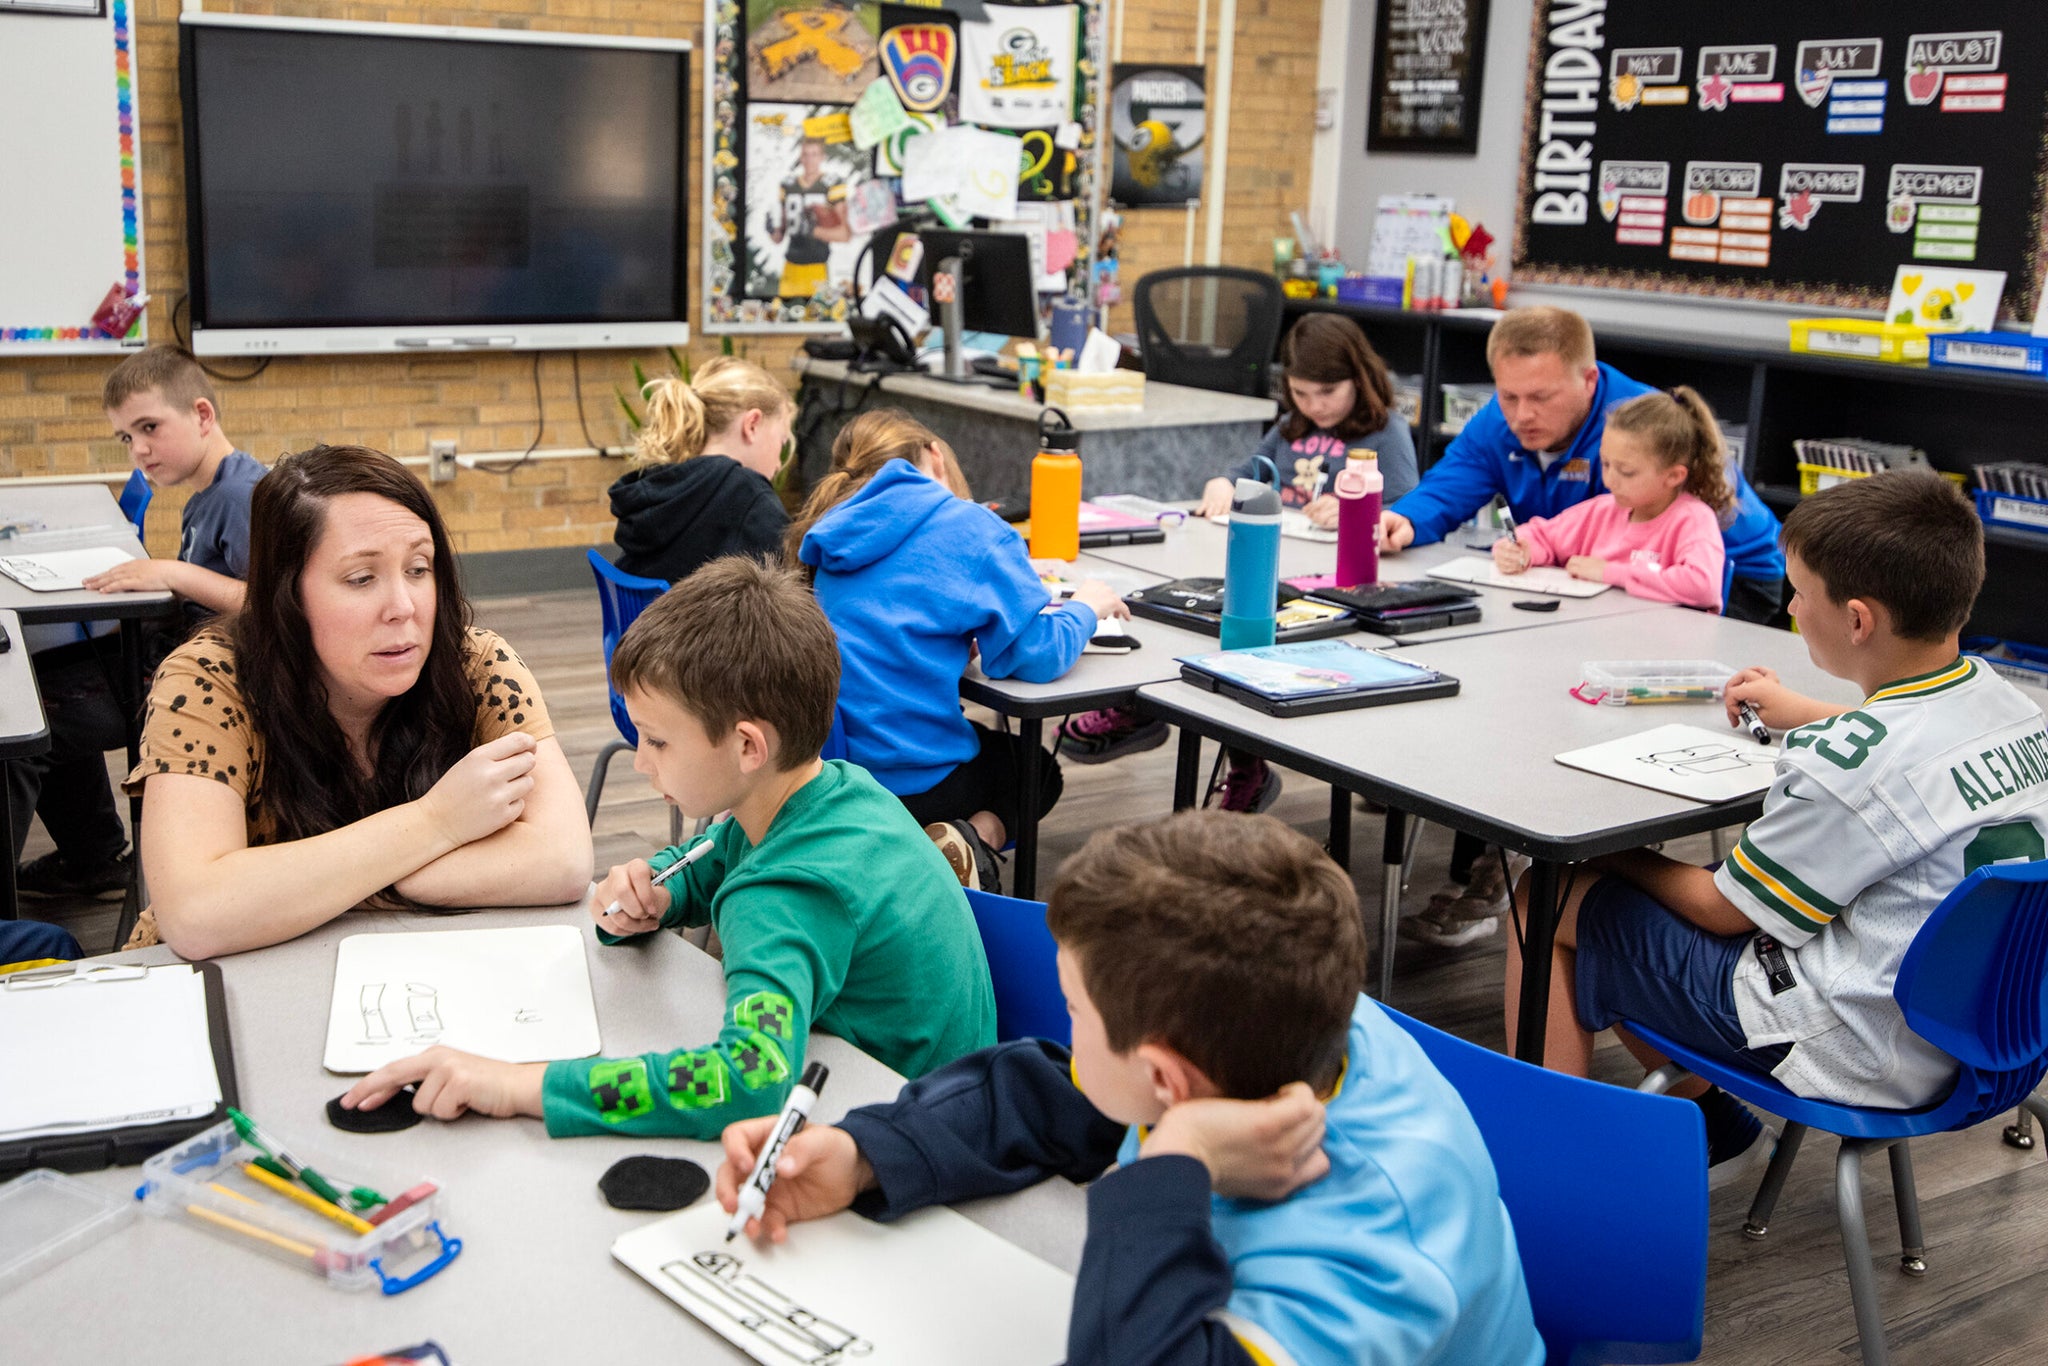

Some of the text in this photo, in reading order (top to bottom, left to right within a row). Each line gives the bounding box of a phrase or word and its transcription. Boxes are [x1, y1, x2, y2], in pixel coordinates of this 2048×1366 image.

[1815, 47, 1862, 69] JULY
[1912, 38, 1996, 63] AUGUST
[1626, 54, 1664, 75] MAY
[1714, 52, 1759, 74] JUNE
[1787, 170, 1859, 193] NOVEMBER
[1895, 173, 1975, 196] DECEMBER
[1291, 436, 1345, 457] LOVE
[1950, 730, 2048, 811] ALEXANDE
